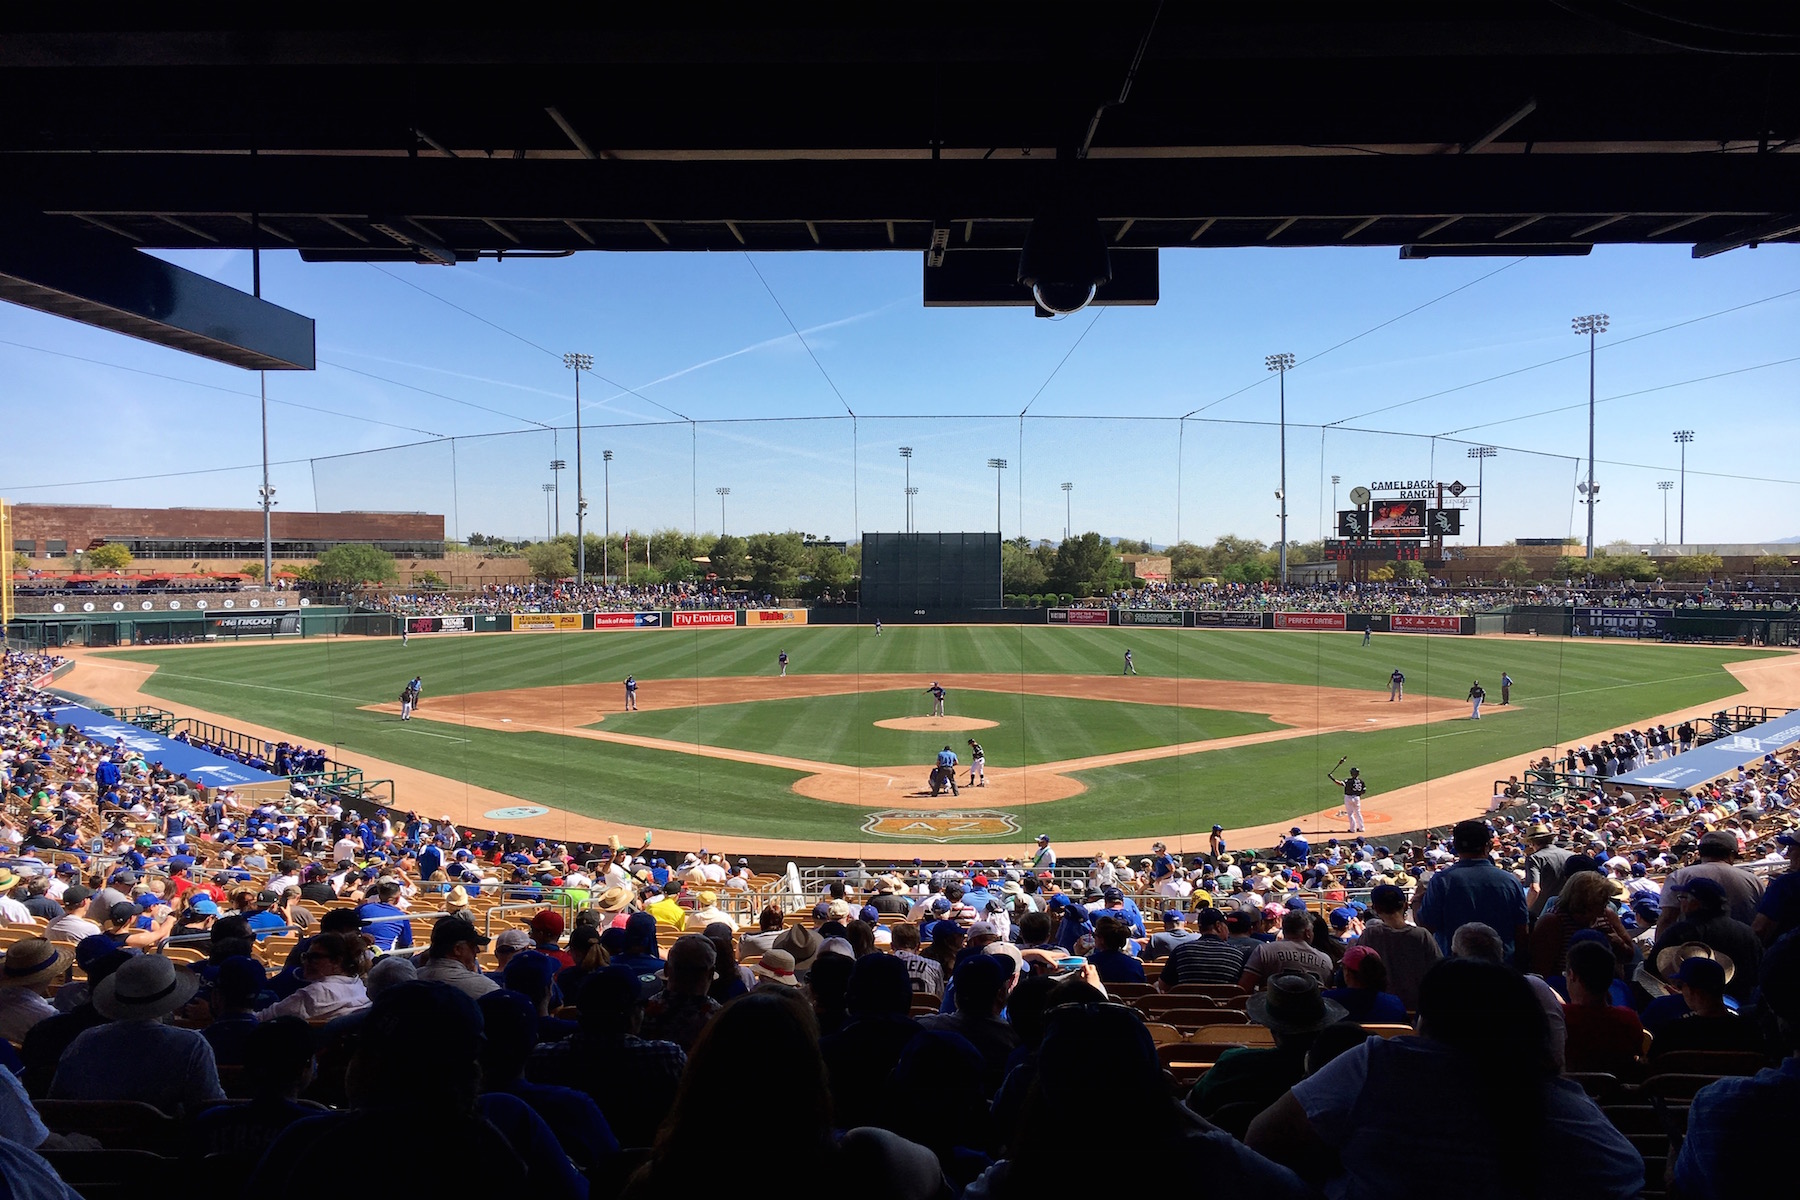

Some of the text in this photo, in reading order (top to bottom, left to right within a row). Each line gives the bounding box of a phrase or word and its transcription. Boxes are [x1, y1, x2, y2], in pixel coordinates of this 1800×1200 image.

[1371, 480, 1434, 490] CAMELBACK
[1400, 489, 1435, 499] RANCH
[1441, 547, 1451, 561] LA
[676, 614, 734, 624] Fly Emirates
[900, 822, 980, 831] AZ
[1277, 950, 1327, 969] BUEHRLE
